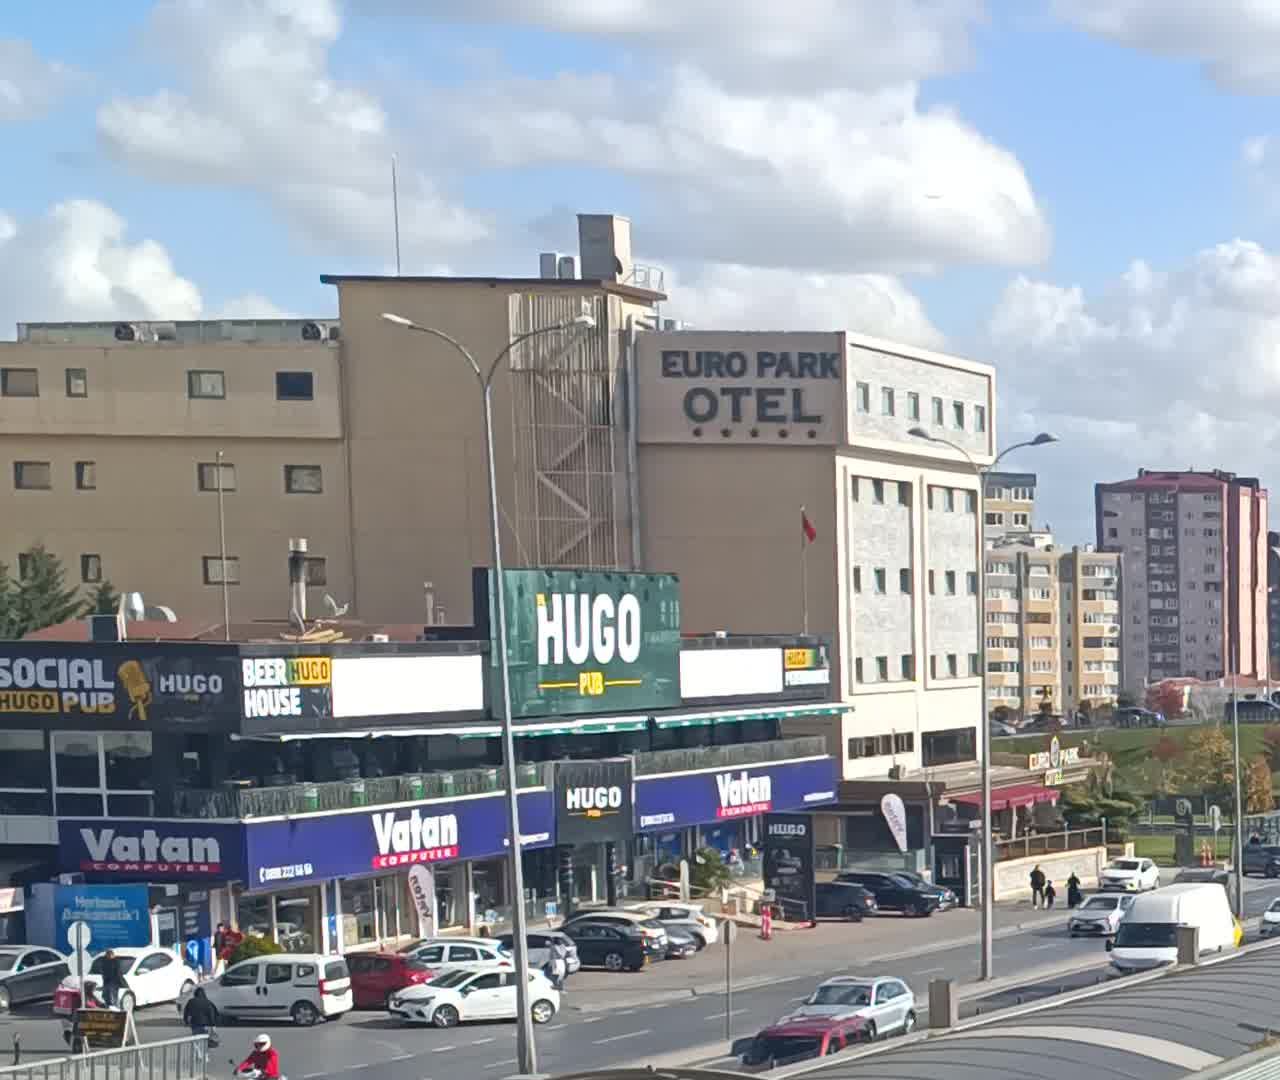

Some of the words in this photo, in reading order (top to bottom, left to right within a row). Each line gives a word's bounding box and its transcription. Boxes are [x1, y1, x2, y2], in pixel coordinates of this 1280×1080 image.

[661, 350, 747, 378] EURO
[756, 351, 841, 379] PARK
[683, 387, 823, 424] OTEL
[536, 592, 641, 665] HUGO
[0, 658, 115, 689] SOCIAL
[158, 674, 223, 694] HUGO
[242, 658, 288, 688] BEER
[290, 660, 329, 682] HUGO
[579, 671, 605, 696] PUB
[62, 691, 117, 713] PUB
[244, 688, 302, 718] HOUSE
[566, 785, 622, 809] HUGO
[715, 770, 772, 809] Vatan
[371, 808, 459, 855] Vatan
[768, 823, 806, 836] HUGO
[79, 827, 220, 863] Vatan
[92, 862, 209, 873] COMPUTER
